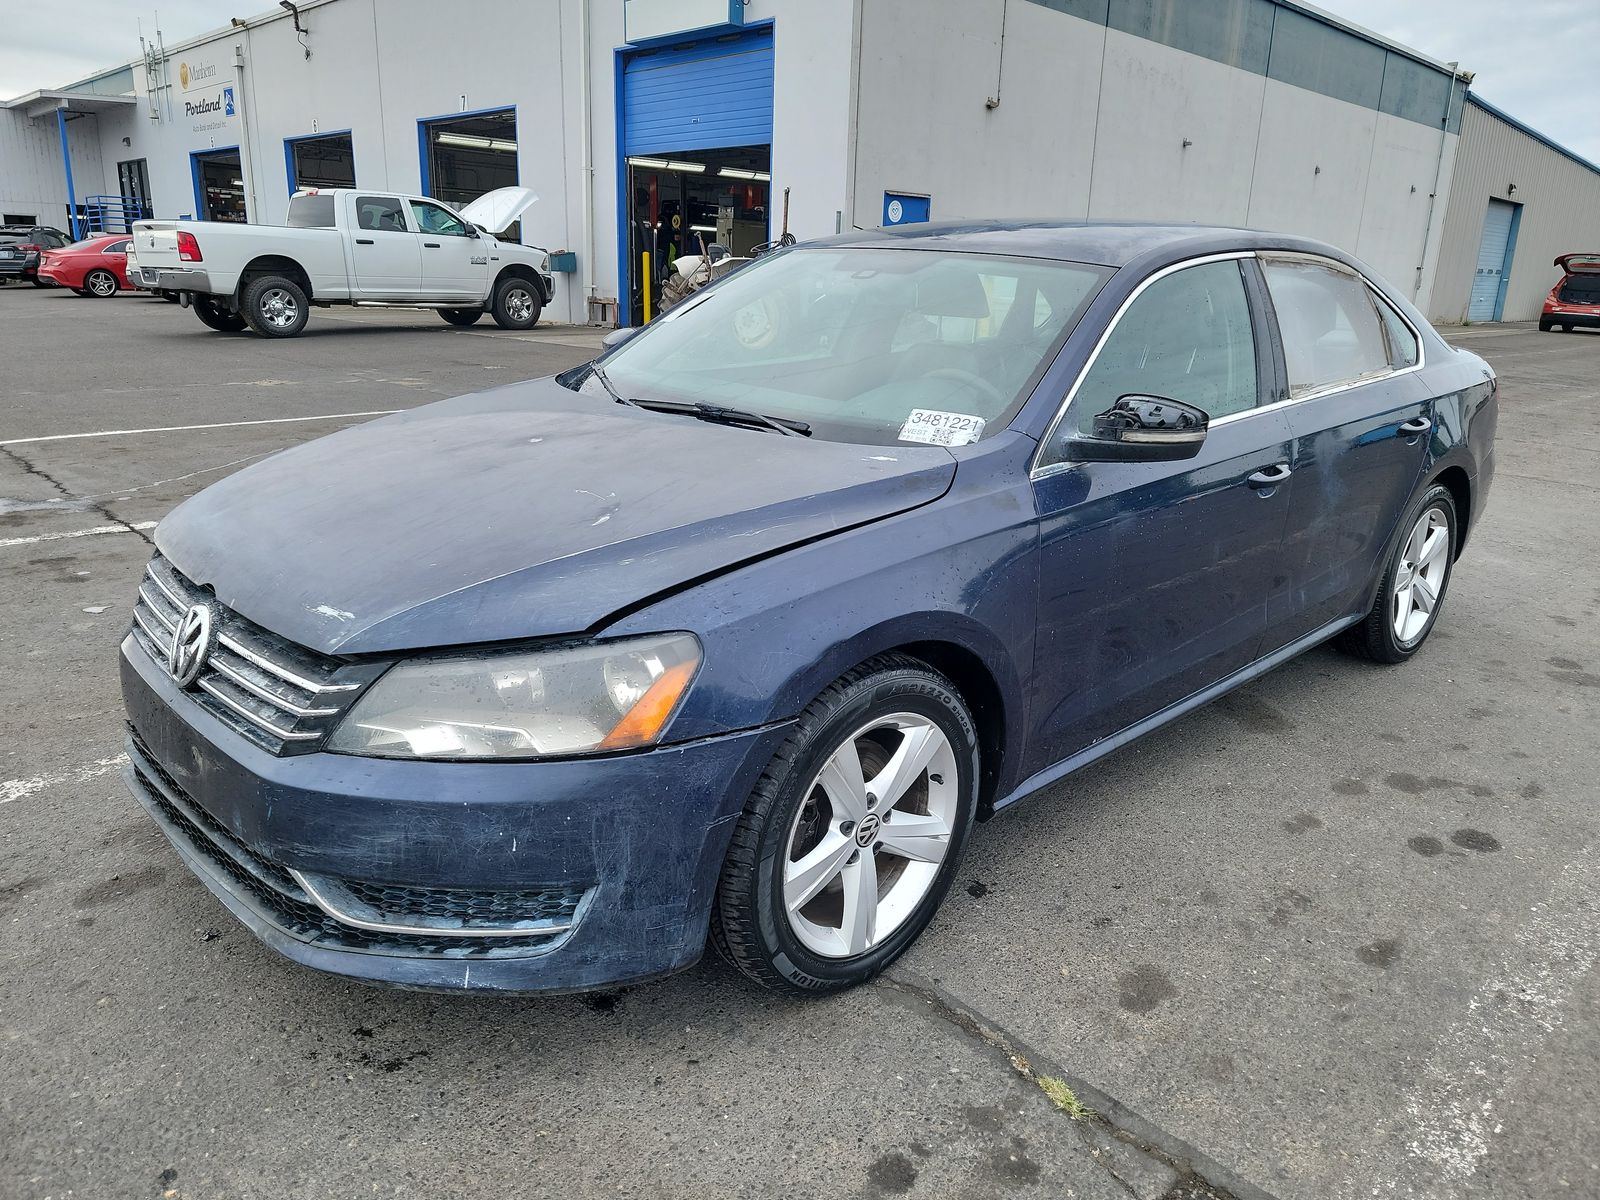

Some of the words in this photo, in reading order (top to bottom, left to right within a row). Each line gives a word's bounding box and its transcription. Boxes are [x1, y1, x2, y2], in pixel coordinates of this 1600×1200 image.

[184, 93, 222, 117] Portland
[461, 95, 466, 112] 7
[911, 412, 979, 432] 3481221
